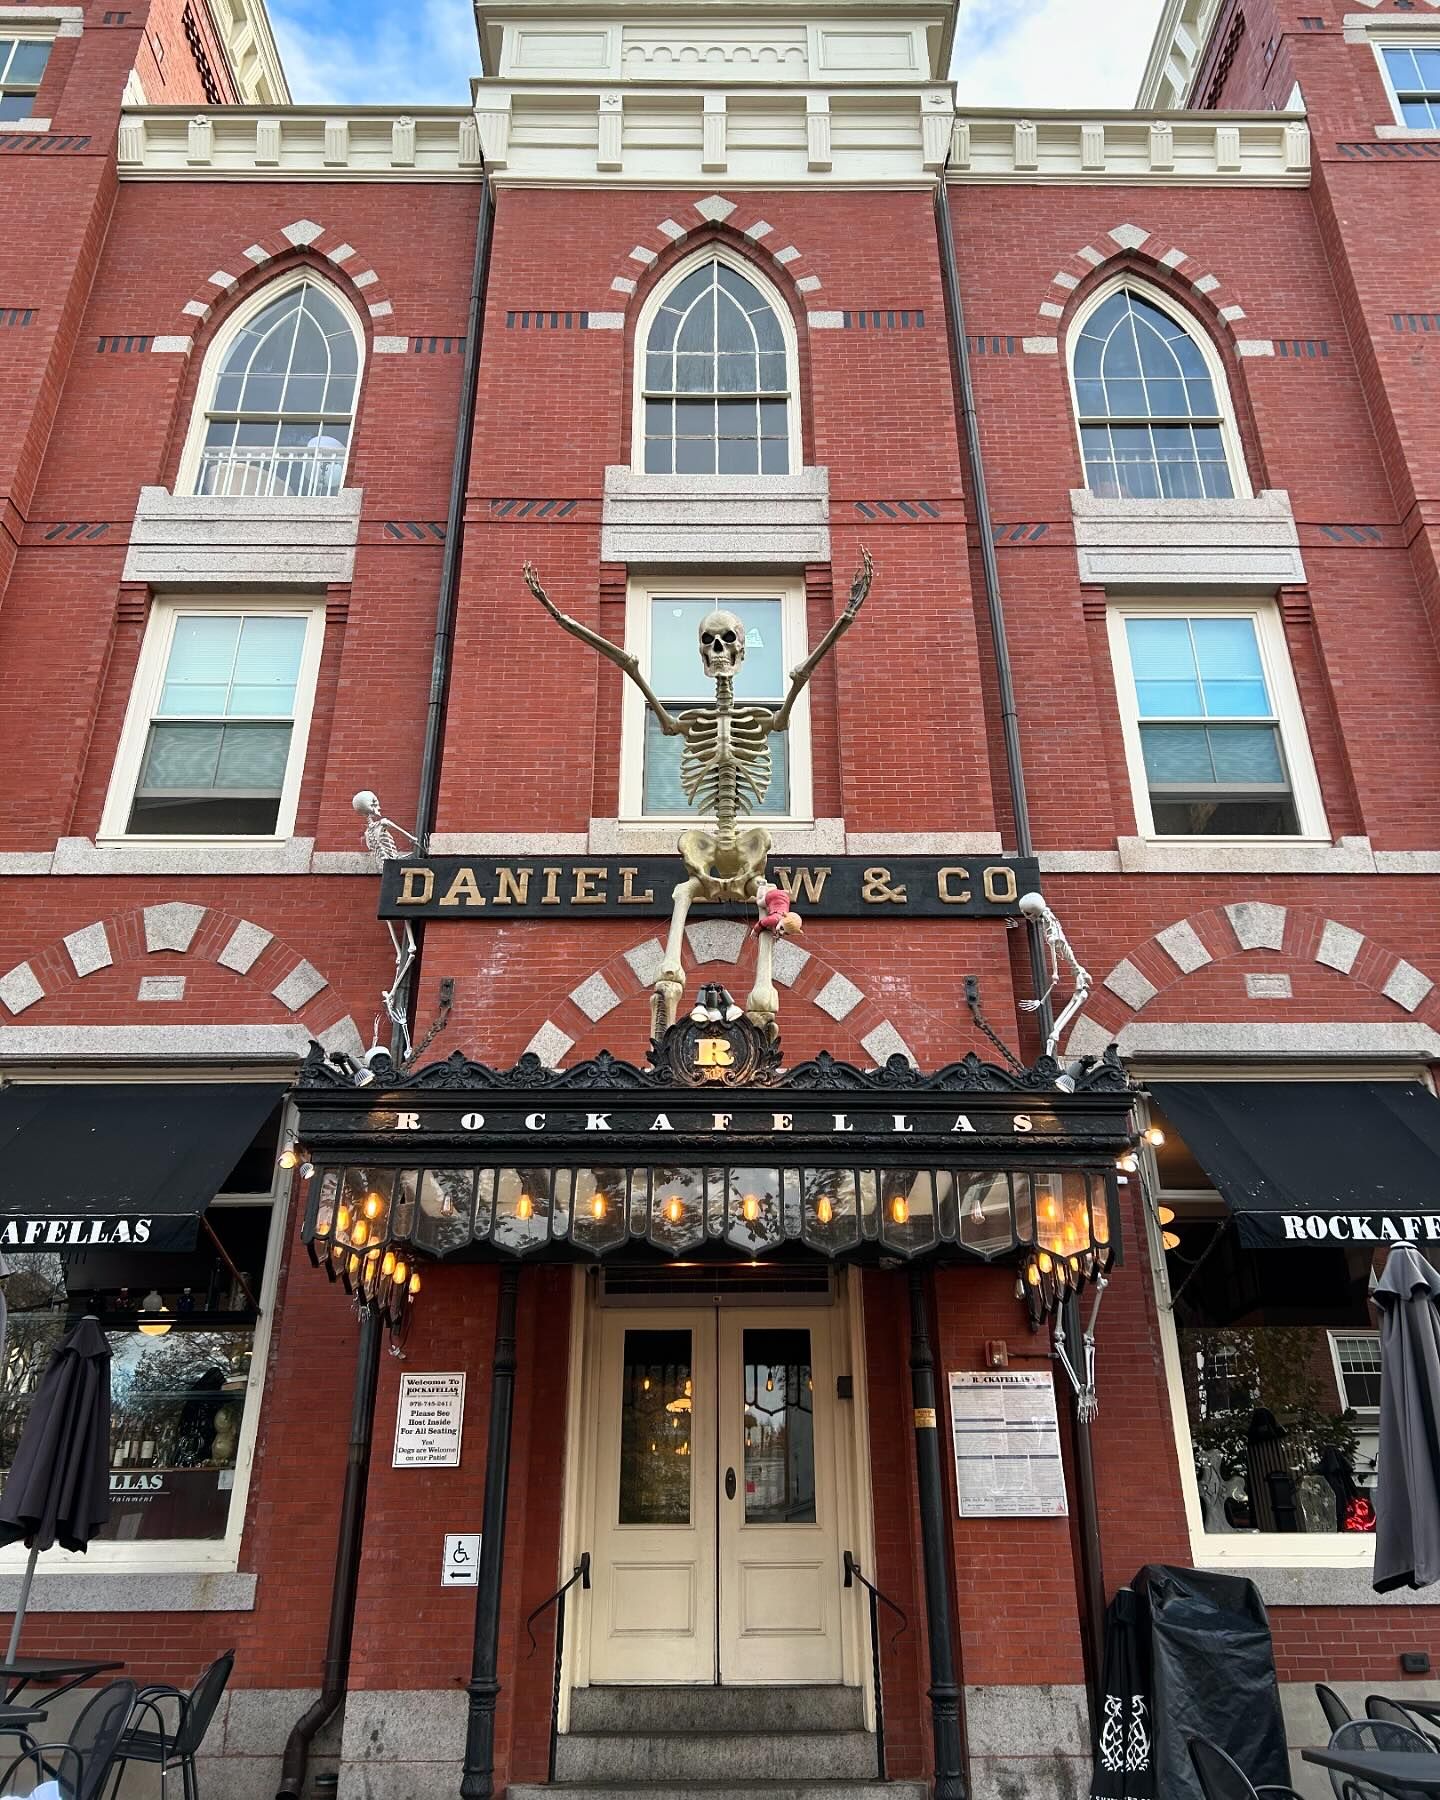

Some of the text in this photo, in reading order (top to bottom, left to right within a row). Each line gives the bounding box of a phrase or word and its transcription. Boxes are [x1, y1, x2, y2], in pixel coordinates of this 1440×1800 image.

[396, 867, 654, 906] DANIEL
[861, 867, 907, 903] &
[937, 866, 1018, 903] CO
[693, 1038, 735, 1066] R
[394, 1112, 1034, 1132] ROCKAFELLAS
[0, 1219, 152, 1244] AFELLAS
[410, 1409, 451, 1417] Please See
[428, 1428, 458, 1436] Seating
